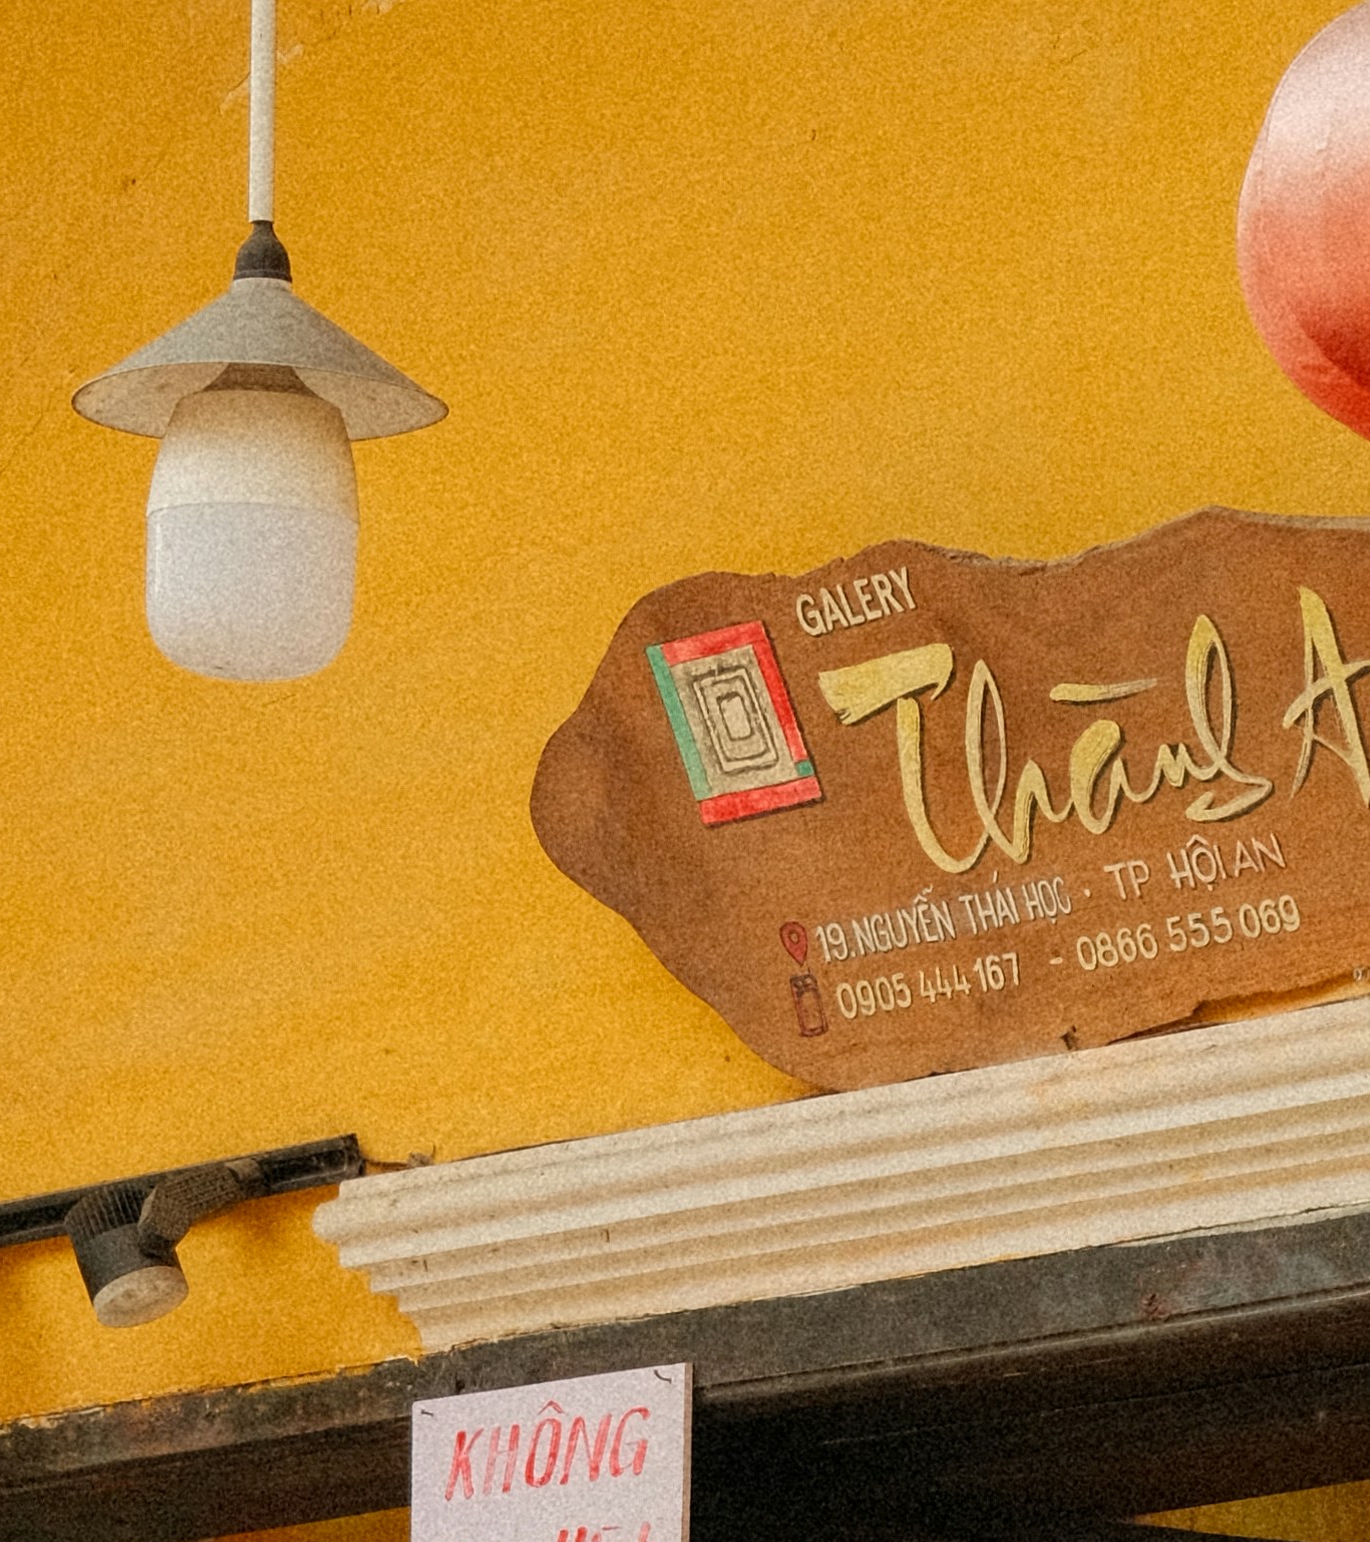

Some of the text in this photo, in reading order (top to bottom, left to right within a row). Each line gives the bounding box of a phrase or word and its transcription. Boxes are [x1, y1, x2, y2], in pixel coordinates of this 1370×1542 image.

[796, 566, 918, 637] GALERY
[958, 870, 1021, 936] THÁI
[1025, 875, 1073, 927] HỌC
[1104, 859, 1152, 902] TP
[1166, 834, 1228, 892] HỘI
[1233, 832, 1287, 878] AN
[835, 972, 914, 1021] 0905
[919, 965, 972, 1004] 444
[972, 950, 1022, 993] 167
[1075, 922, 1160, 972] 0866
[1165, 906, 1234, 953] 555
[1237, 893, 1303, 940] 069
[443, 1399, 652, 1502] KHÔNG
